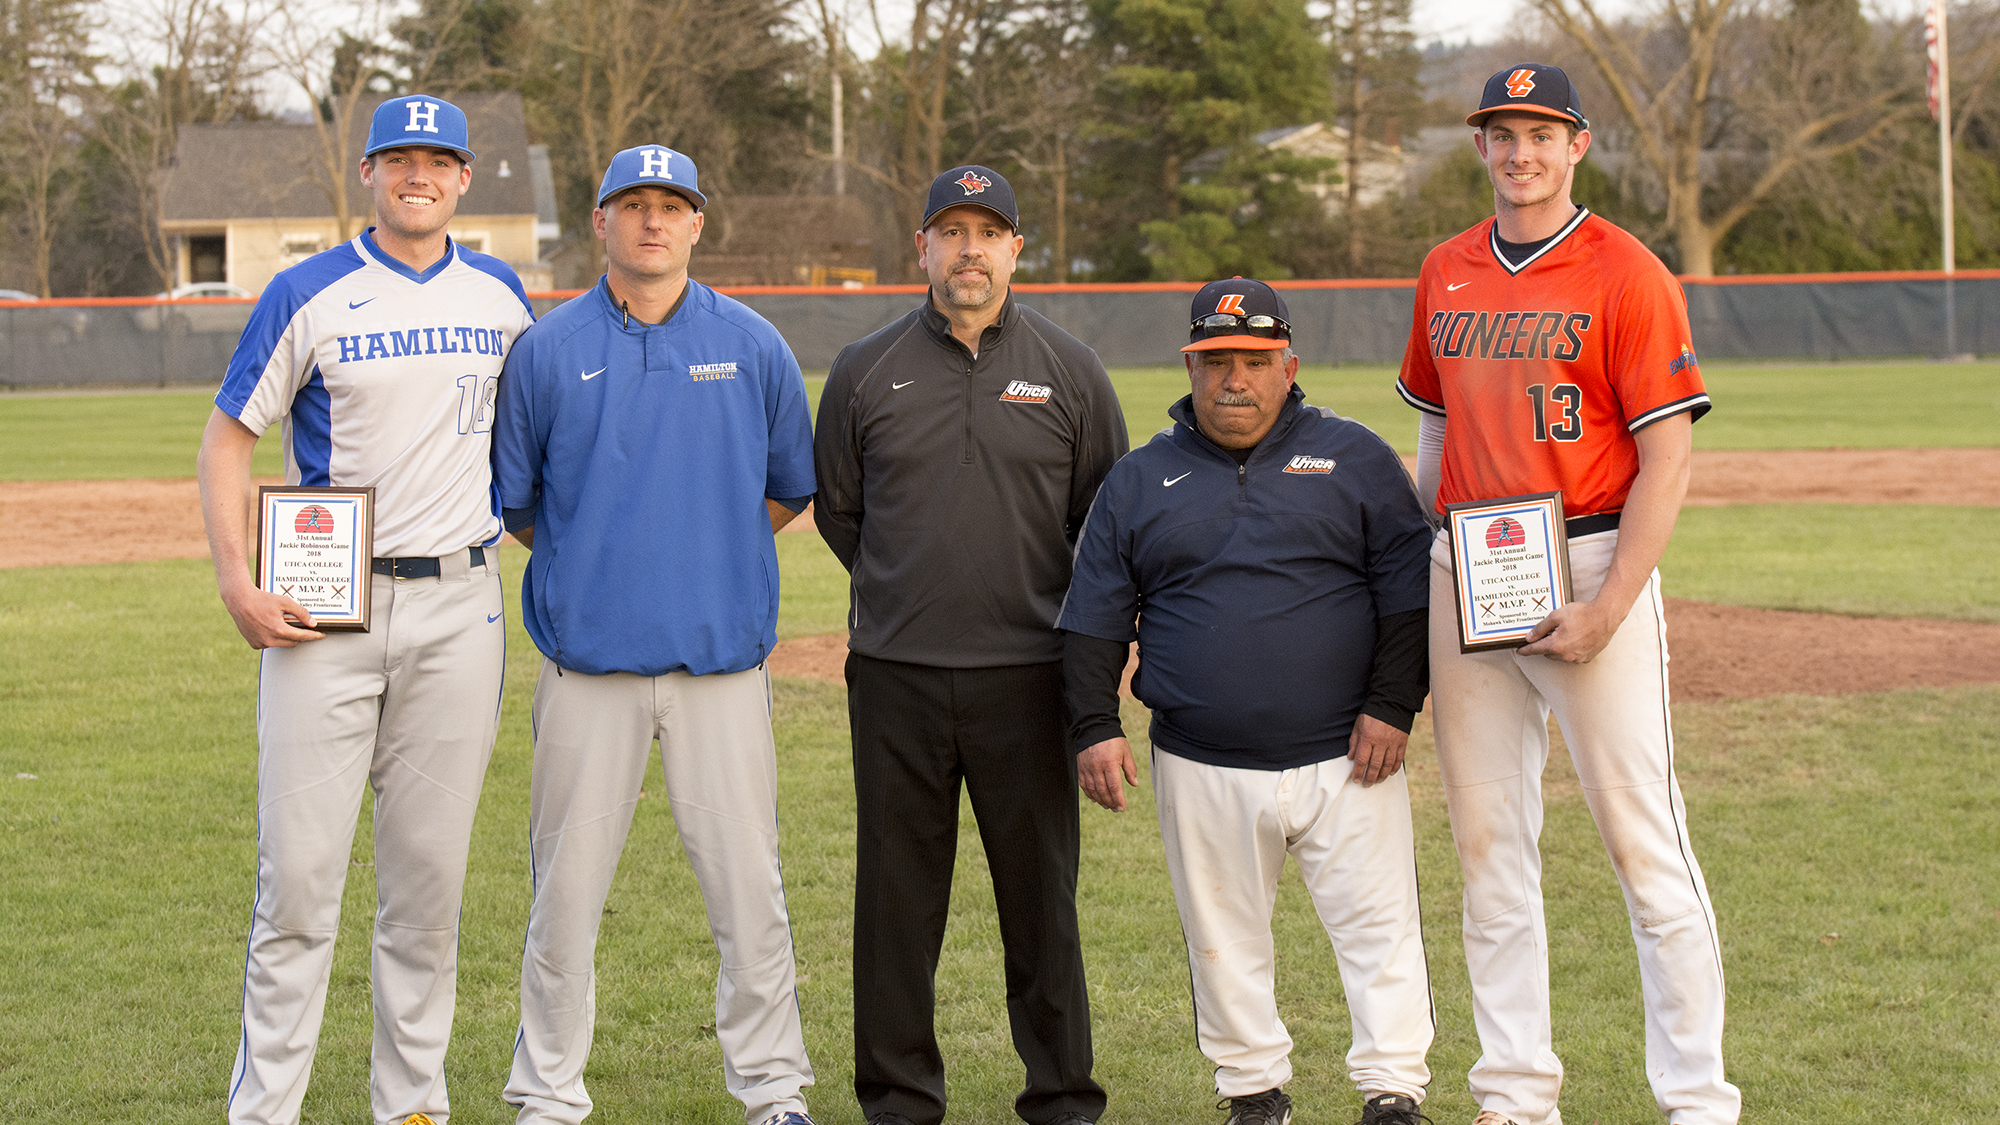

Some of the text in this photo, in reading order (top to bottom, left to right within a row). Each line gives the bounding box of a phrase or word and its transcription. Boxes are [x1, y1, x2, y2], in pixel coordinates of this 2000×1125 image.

[405, 101, 439, 133] H
[639, 149, 672, 180] H
[1430, 311, 1592, 362] PIONEERS
[337, 327, 503, 363] HAMILTON
[689, 362, 737, 373] HAMILTON
[693, 373, 735, 382] BASEBALL
[1007, 382, 1050, 397] UTICA
[1527, 383, 1583, 442] 13
[1290, 456, 1334, 469] UTICA
[1503, 546, 1526, 555] Annual
[1473, 558, 1493, 567] Jackie
[1495, 556, 1524, 564] Robinson
[1481, 572, 1541, 585] UTICA COLLEGE
[298, 585, 325, 593] M.V.P.
[1474, 586, 1551, 602] HAMILTON COLLEGE
[1499, 599, 1526, 609] M.V.P.
[1380, 1097, 1396, 1105] NIKE
